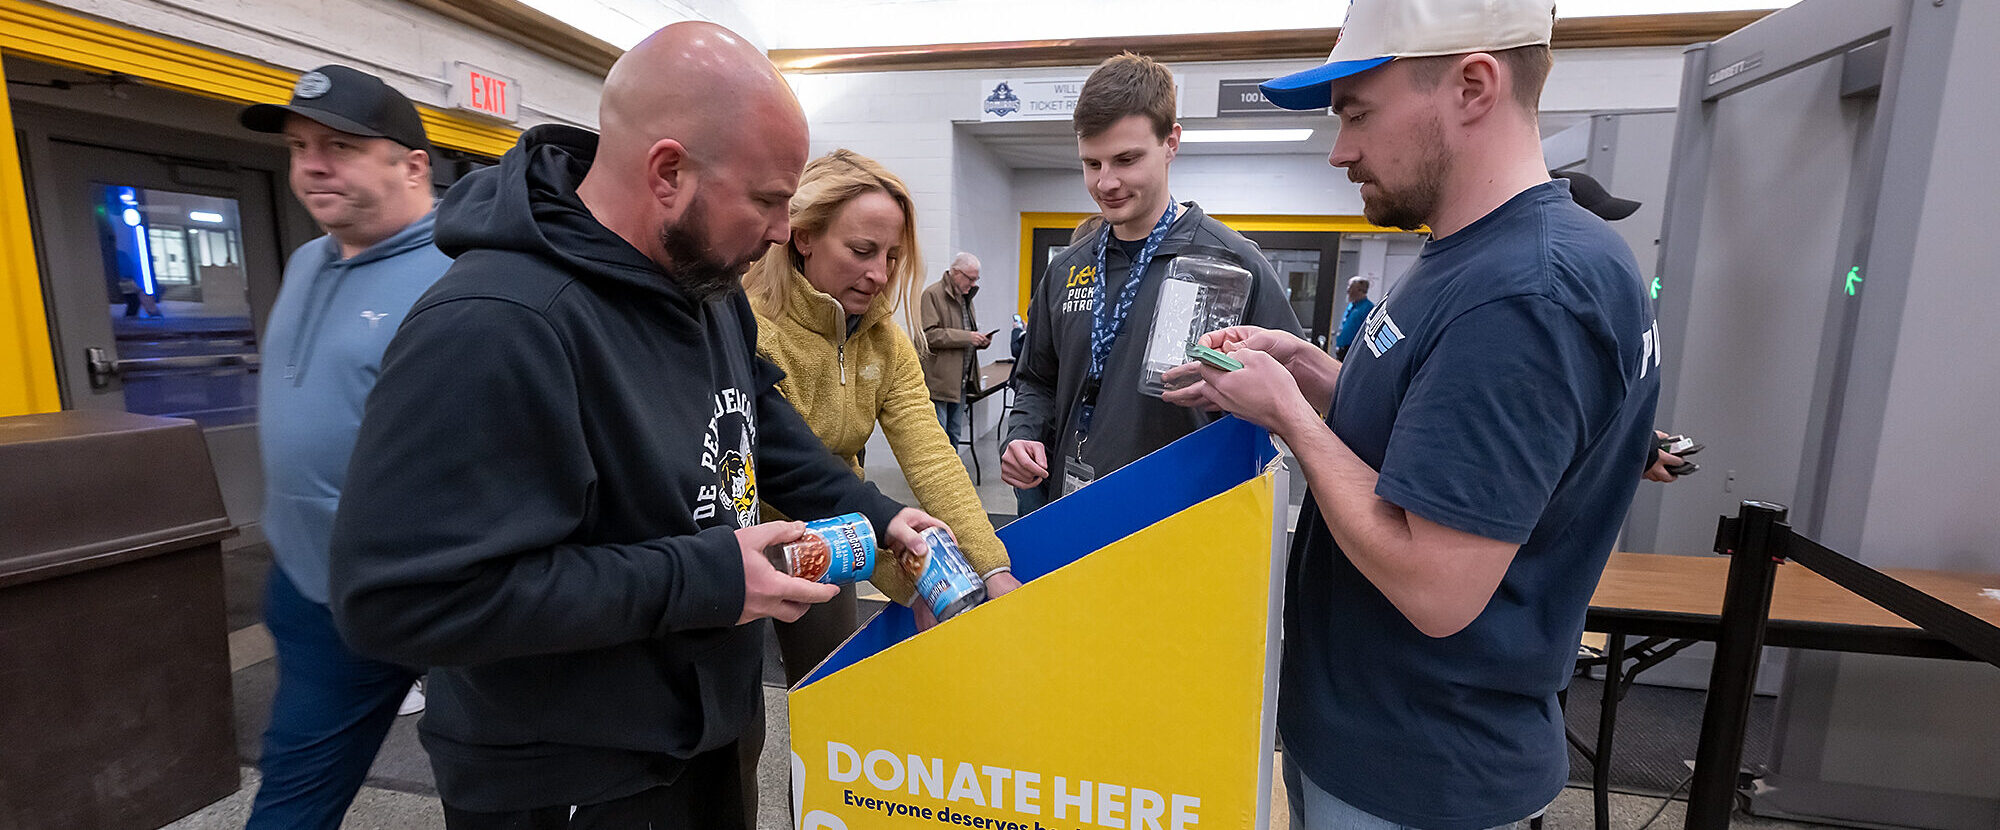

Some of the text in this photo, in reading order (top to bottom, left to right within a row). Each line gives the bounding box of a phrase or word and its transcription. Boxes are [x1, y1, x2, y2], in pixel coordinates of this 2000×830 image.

[470, 71, 506, 115] EXIT
[1054, 84, 1078, 94] WILL
[1241, 92, 1259, 103] 100
[1030, 101, 1063, 111] TICKET
[1066, 100, 1078, 110] RE
[1062, 299, 1094, 315] PATRO
[1067, 286, 1095, 301] PUCK
[693, 484, 717, 522] DE
[844, 523, 866, 568] PROGRESSO
[827, 740, 1041, 816] DONATE
[1053, 775, 1201, 830] HERE
[843, 789, 933, 820] Everyone
[936, 806, 1029, 830] deserves
